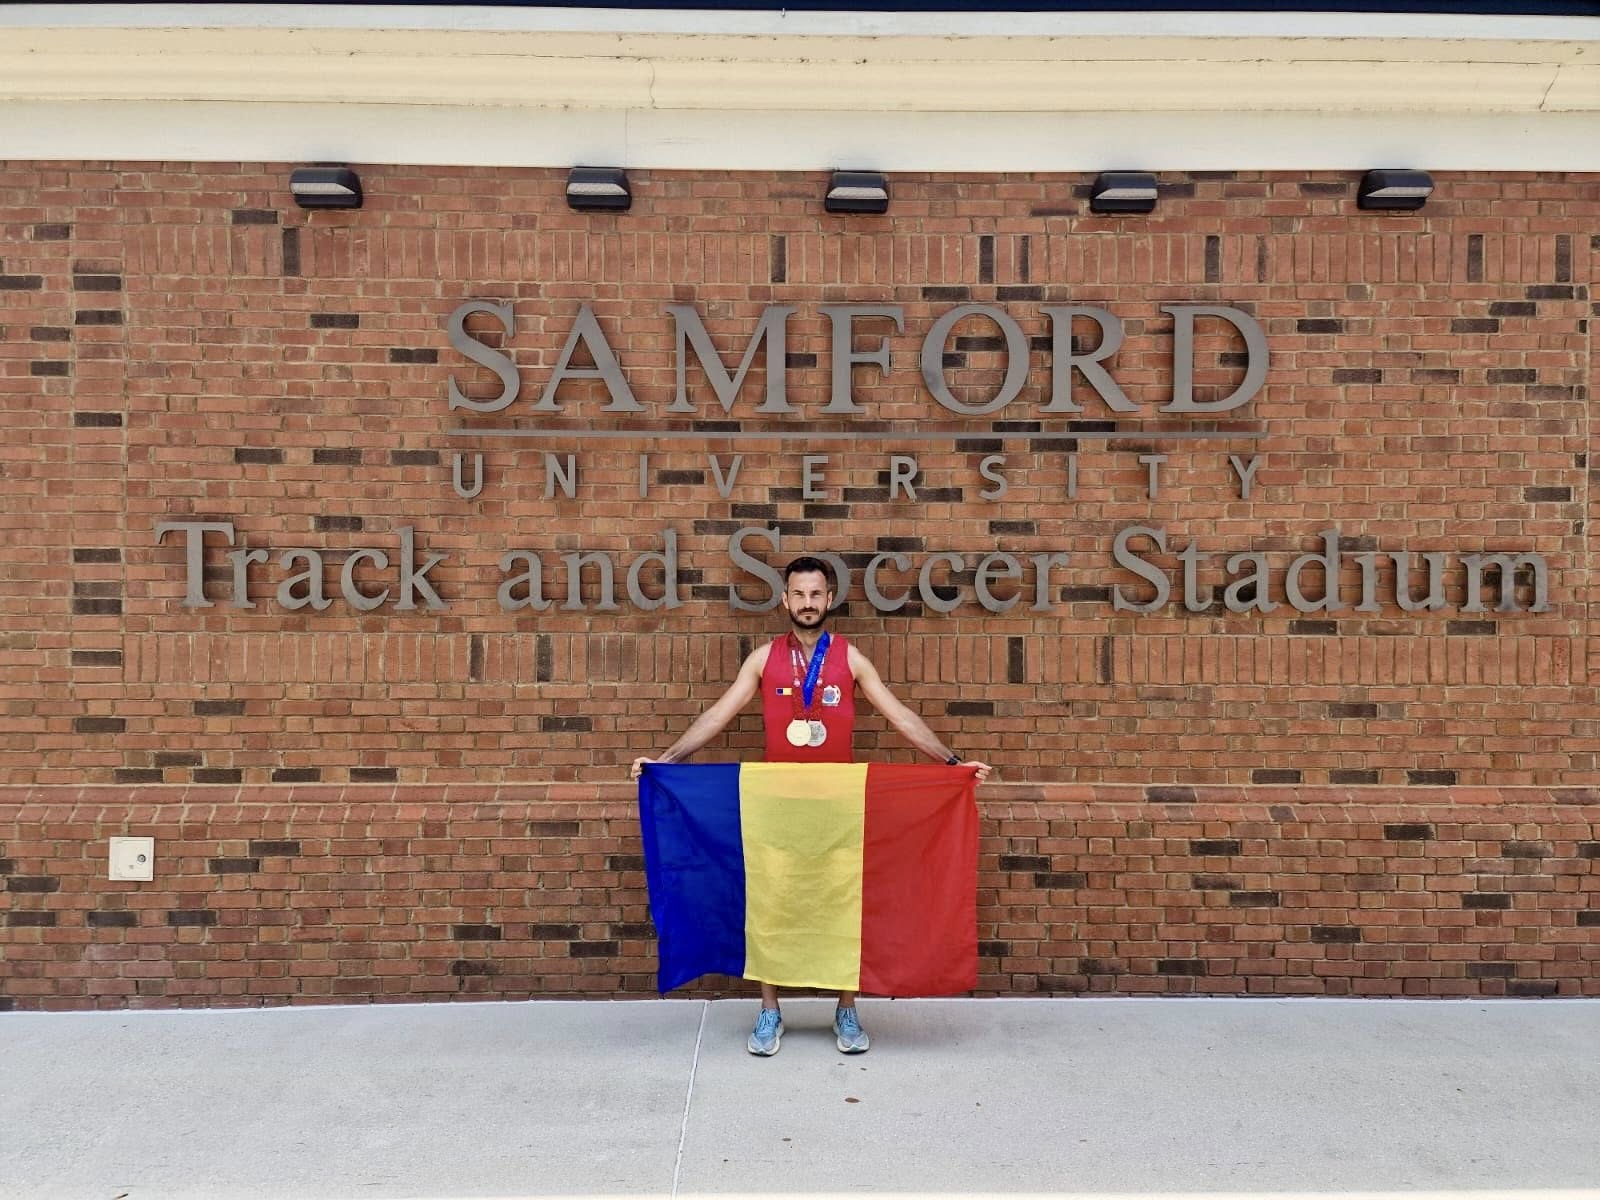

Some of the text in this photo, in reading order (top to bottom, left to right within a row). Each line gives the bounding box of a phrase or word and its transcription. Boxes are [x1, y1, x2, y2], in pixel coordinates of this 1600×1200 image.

[447, 301, 1269, 415] SAMFORD
[453, 453, 1260, 500] UNIVERSITY
[156, 521, 451, 611] Track
[499, 529, 682, 612] and
[1112, 526, 1550, 614] Stadium
